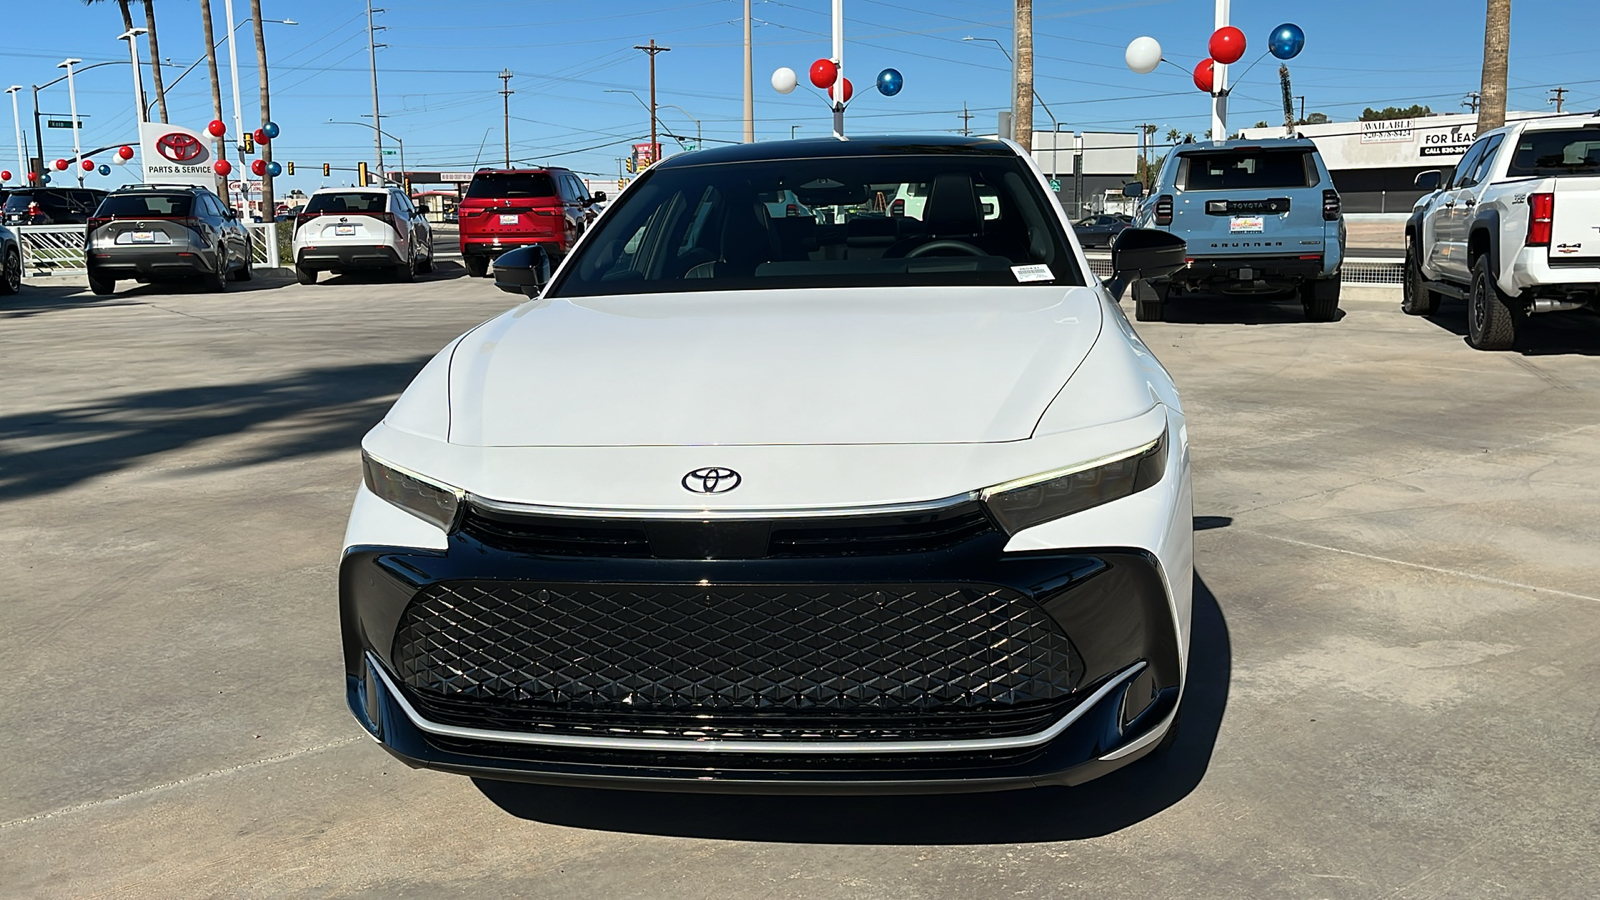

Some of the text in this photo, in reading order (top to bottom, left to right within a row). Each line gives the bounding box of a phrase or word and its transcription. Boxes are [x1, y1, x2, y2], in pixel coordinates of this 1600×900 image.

[1363, 120, 1413, 130] AVAILABLE
[1425, 132, 1477, 144] FOR LEAS
